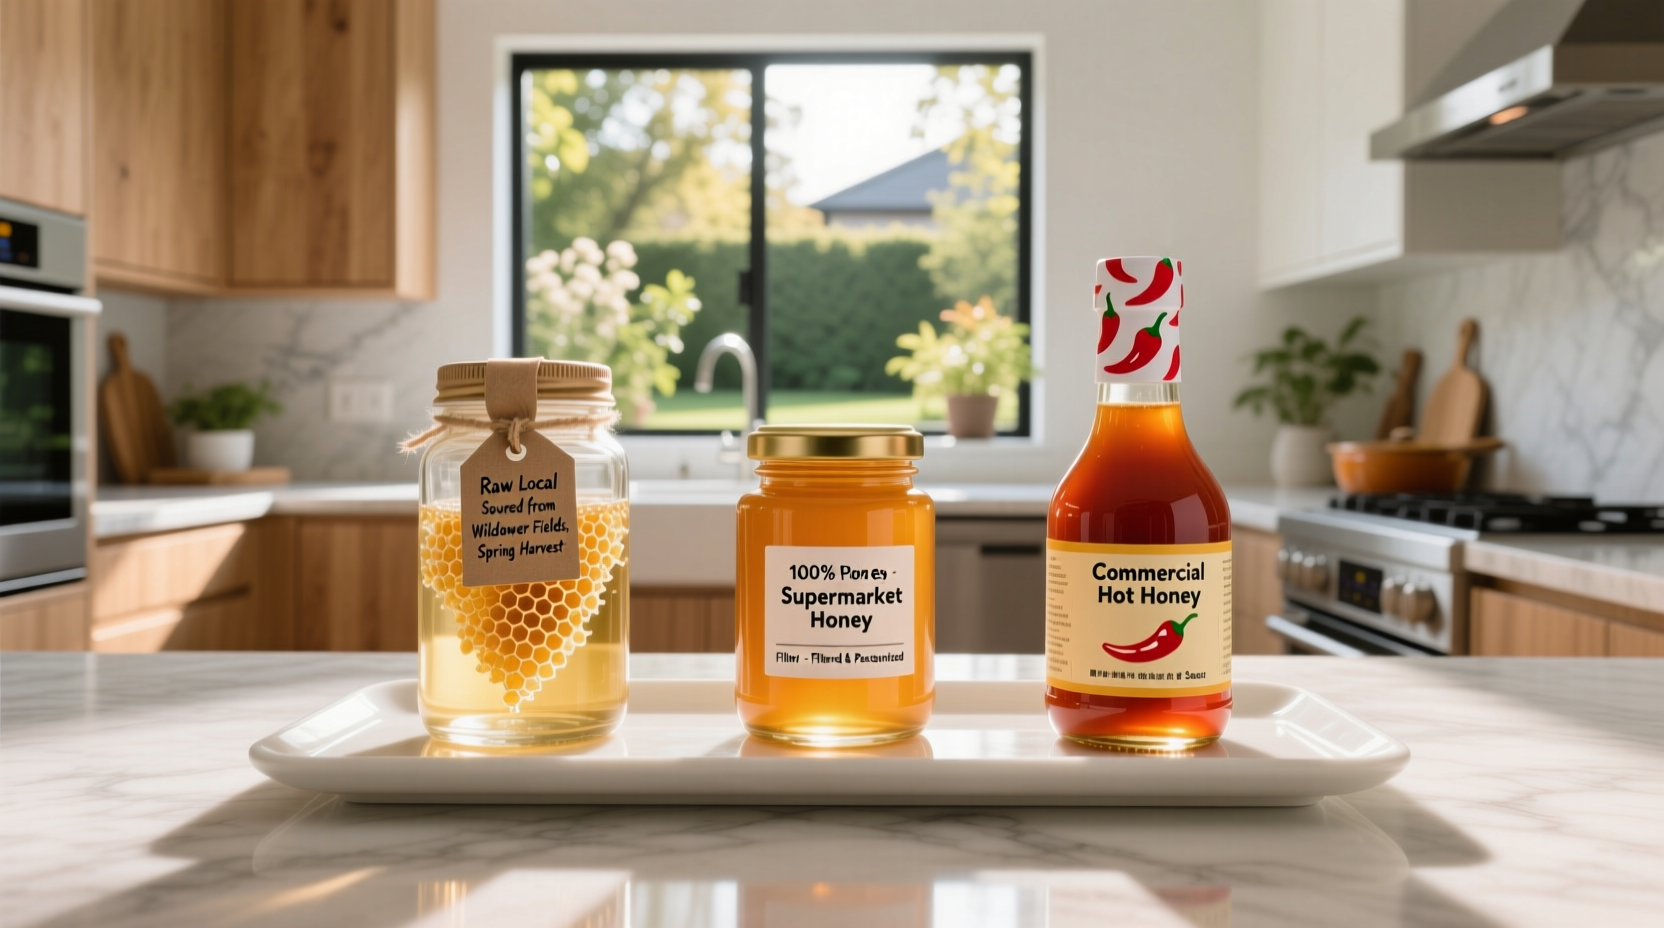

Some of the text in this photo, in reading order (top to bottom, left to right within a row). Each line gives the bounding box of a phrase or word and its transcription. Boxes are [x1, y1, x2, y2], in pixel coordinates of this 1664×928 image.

[480, 472, 558, 495] Raw Local
[482, 496, 556, 515] Soured from
[478, 540, 565, 563] Spring Harvest
[789, 564, 836, 581] 100%
[1092, 561, 1205, 581] Commercial
[781, 586, 903, 610] Supermarket
[1098, 585, 1201, 609] Hot Honey
[811, 611, 873, 633] Honey
